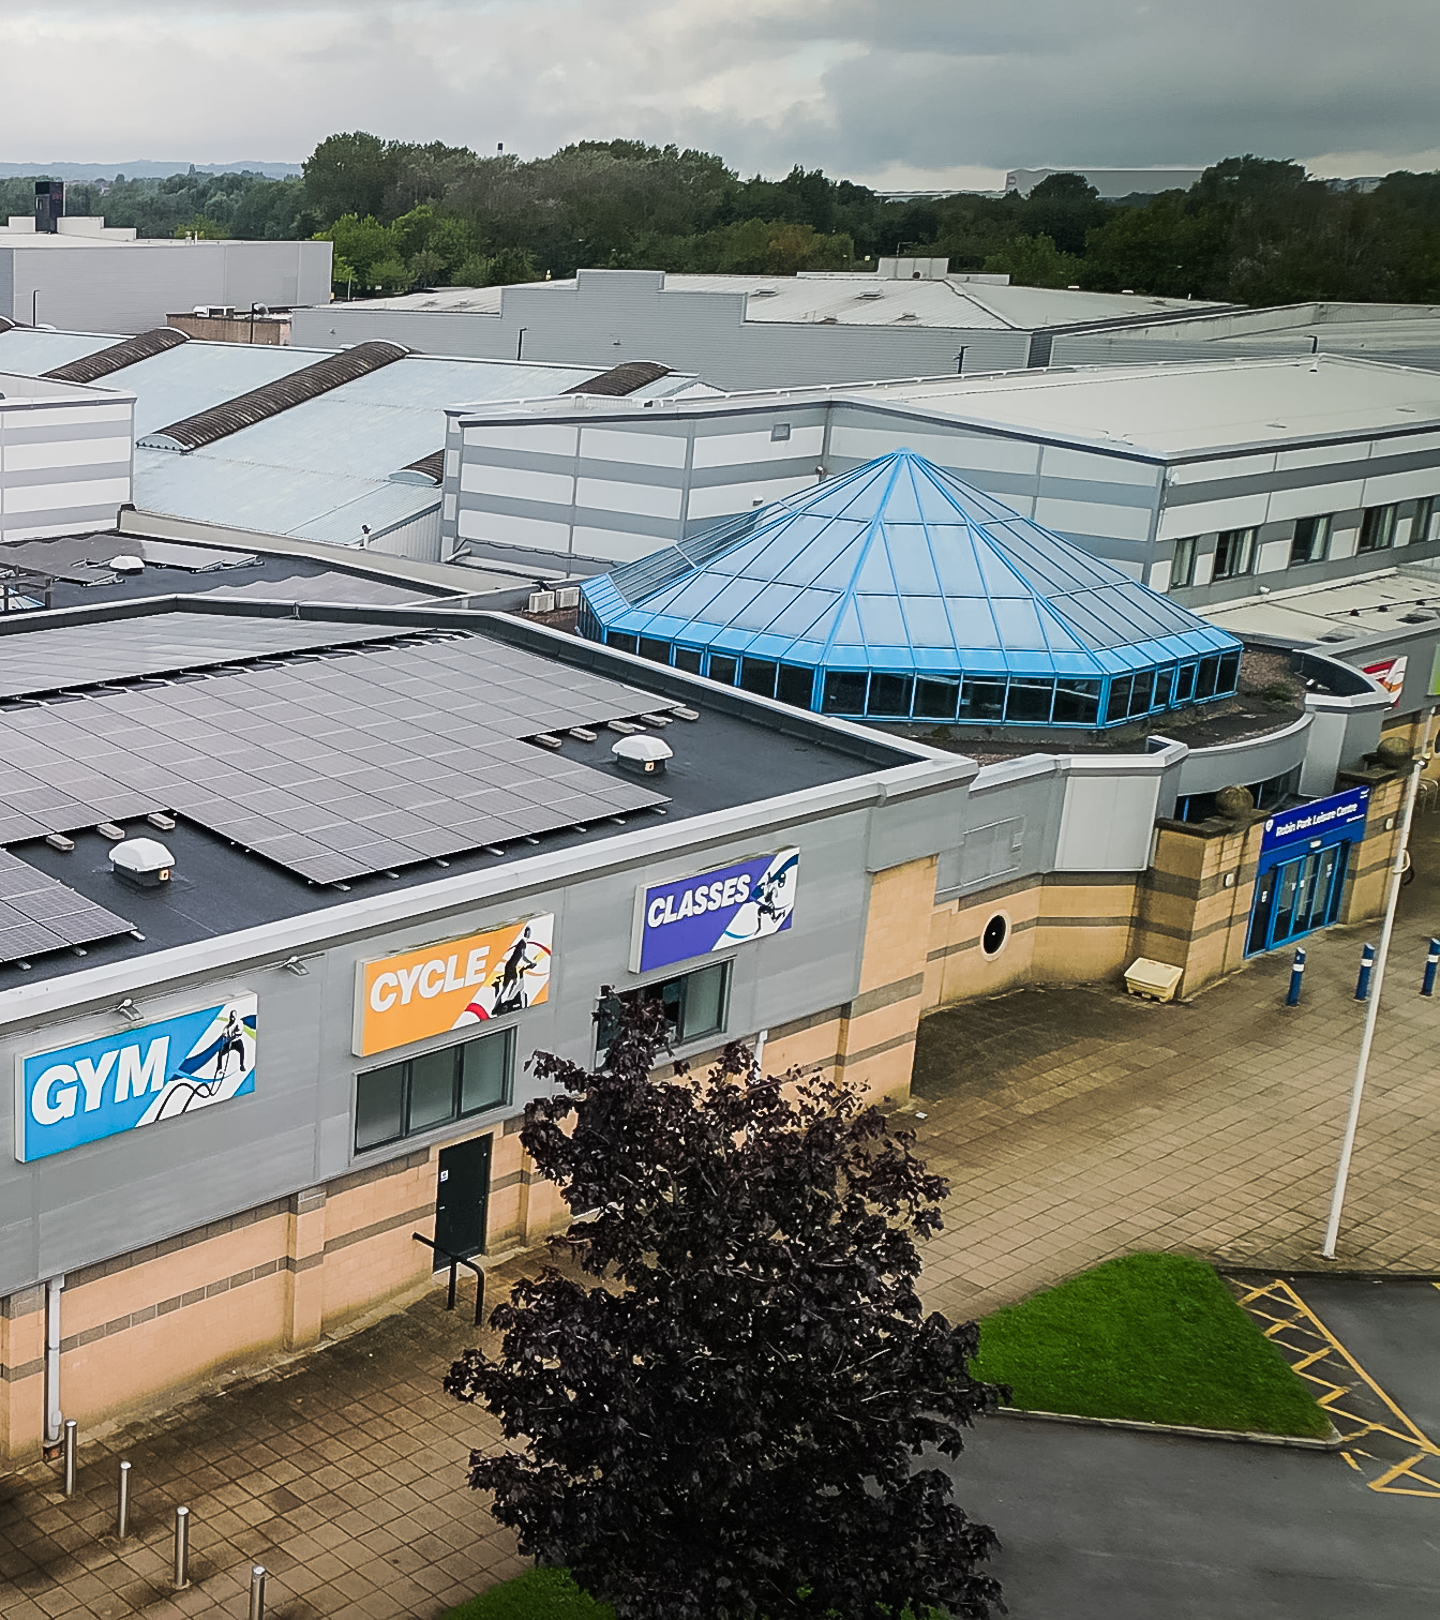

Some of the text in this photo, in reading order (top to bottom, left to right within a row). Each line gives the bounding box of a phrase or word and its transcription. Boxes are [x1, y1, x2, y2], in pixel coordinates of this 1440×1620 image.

[1275, 821, 1296, 837] Robin
[1296, 816, 1313, 830] Park
[1312, 811, 1337, 825] Leisure
[1336, 803, 1358, 817] Centre
[647, 873, 752, 928] CLASSES
[370, 945, 491, 1012] CYCLE
[31, 1035, 170, 1125] GYM
